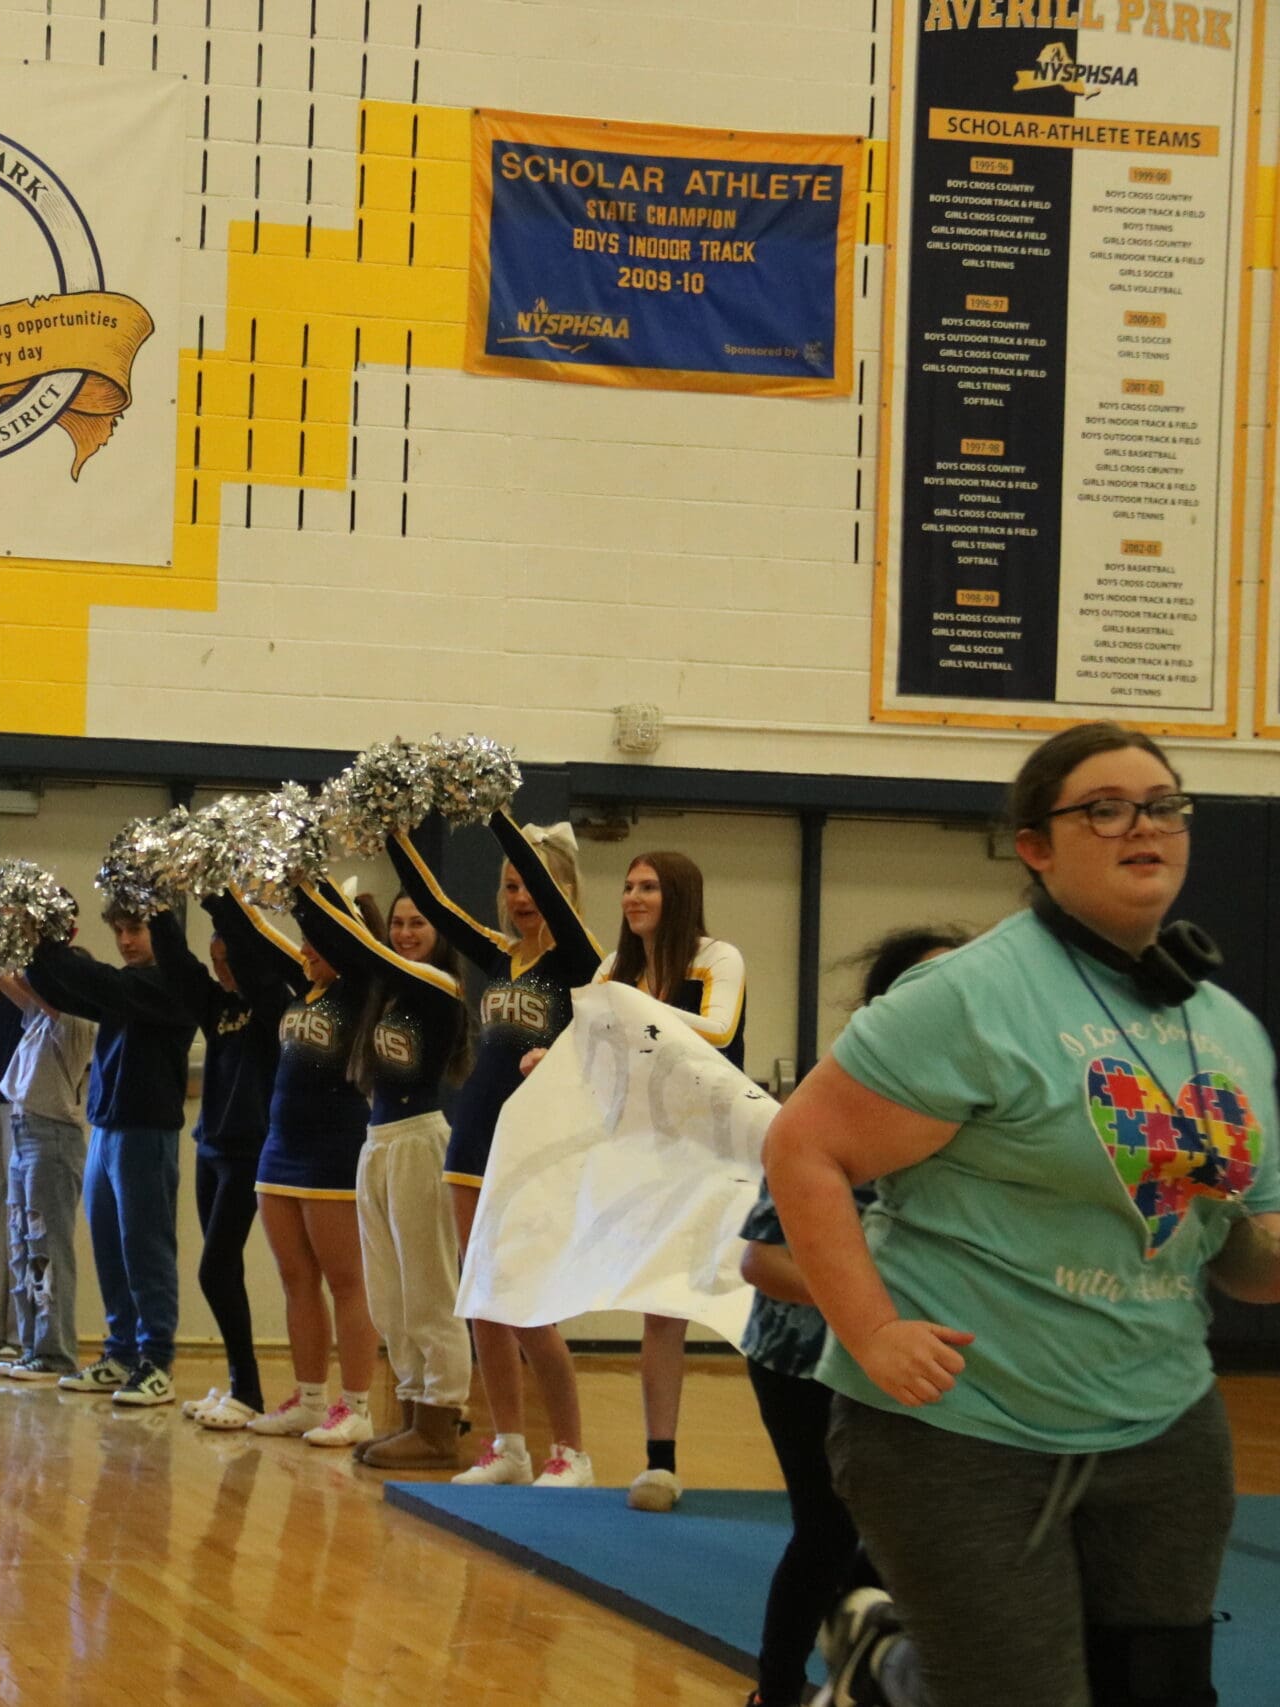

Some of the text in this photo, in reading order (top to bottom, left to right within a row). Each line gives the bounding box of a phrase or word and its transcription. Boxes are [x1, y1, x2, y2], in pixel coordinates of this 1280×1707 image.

[925, 0, 1232, 50] AVERILL PARK
[1033, 61, 1139, 87] NYSPHSAA
[947, 116, 1201, 148] SCHOLAR-ATHLETE TEAMS
[500, 151, 832, 201] SCHOLAR ATHLETE
[947, 179, 1035, 192] BOYS CROSS COUNTRY
[929, 194, 950, 203] BOYS
[952, 196, 992, 206] OUTDOOR
[994, 199, 1019, 207] TRACK
[1028, 201, 1052, 209] FIELD
[586, 199, 737, 229] STATE CHAMPION
[945, 211, 1035, 224] GIRLS CROSS COUNTRY
[932, 226, 954, 234] GIRLS
[956, 227, 988, 237] INDOOR
[990, 229, 1015, 238] TRACK
[1024, 232, 1047, 240] FIELD
[573, 227, 756, 263] BOYS INDOOR TRACK
[927, 242, 950, 250] GIRLS
[952, 243, 991, 252] OUTDOOR
[993, 245, 1019, 254] TRACK
[1028, 247, 1051, 256] FIELD
[962, 259, 1015, 269] GIRLS TENNIS
[16, 310, 118, 334] opportunities
[517, 312, 630, 339] NYSPHSAA
[942, 318, 1030, 330] BOYS CROSS COUNTRY
[924, 333, 945, 341] BOYS
[947, 334, 988, 343] OUTDOOR
[990, 336, 1014, 345] TRACK
[1024, 338, 1047, 346] FIELD
[17, 344, 43, 363] day
[724, 343, 782, 356] Sponsored
[784, 346, 797, 359] by
[940, 349, 1030, 361] GIRLS CROSS COUNTRY
[923, 364, 945, 373] GIRLS
[947, 365, 988, 375] OUTDOOR
[990, 368, 1014, 376] TRACK
[1024, 369, 1047, 378] FIELD
[958, 381, 1011, 391] GIRLS TENNIS
[964, 397, 1004, 406] SOFTBALL
[936, 462, 1026, 473] BOYS CROSS COUNTRY
[924, 477, 944, 485] BOYS
[946, 478, 979, 487] INDOOR
[981, 480, 1006, 488] TRACK
[1015, 481, 1038, 489] FIELD
[959, 494, 1001, 503] FOOTBALL
[934, 509, 1025, 520] GIRLS CROSS COUNTRY
[922, 523, 944, 532] GIRLS
[946, 524, 978, 533] INDOOR
[980, 526, 1005, 534] TRACK
[1014, 528, 1037, 536] FIELD
[952, 540, 1005, 550] GIRLS TENNIS
[958, 557, 998, 565] SOFTBALL
[933, 613, 1022, 624] BOYS CROSS COUNTRY
[932, 628, 1022, 639] GIRLS CROSS COUNTRY
[949, 644, 1003, 654] GIRLS SOCCER
[939, 660, 1013, 671] GIRLS VOLLEYBALL
